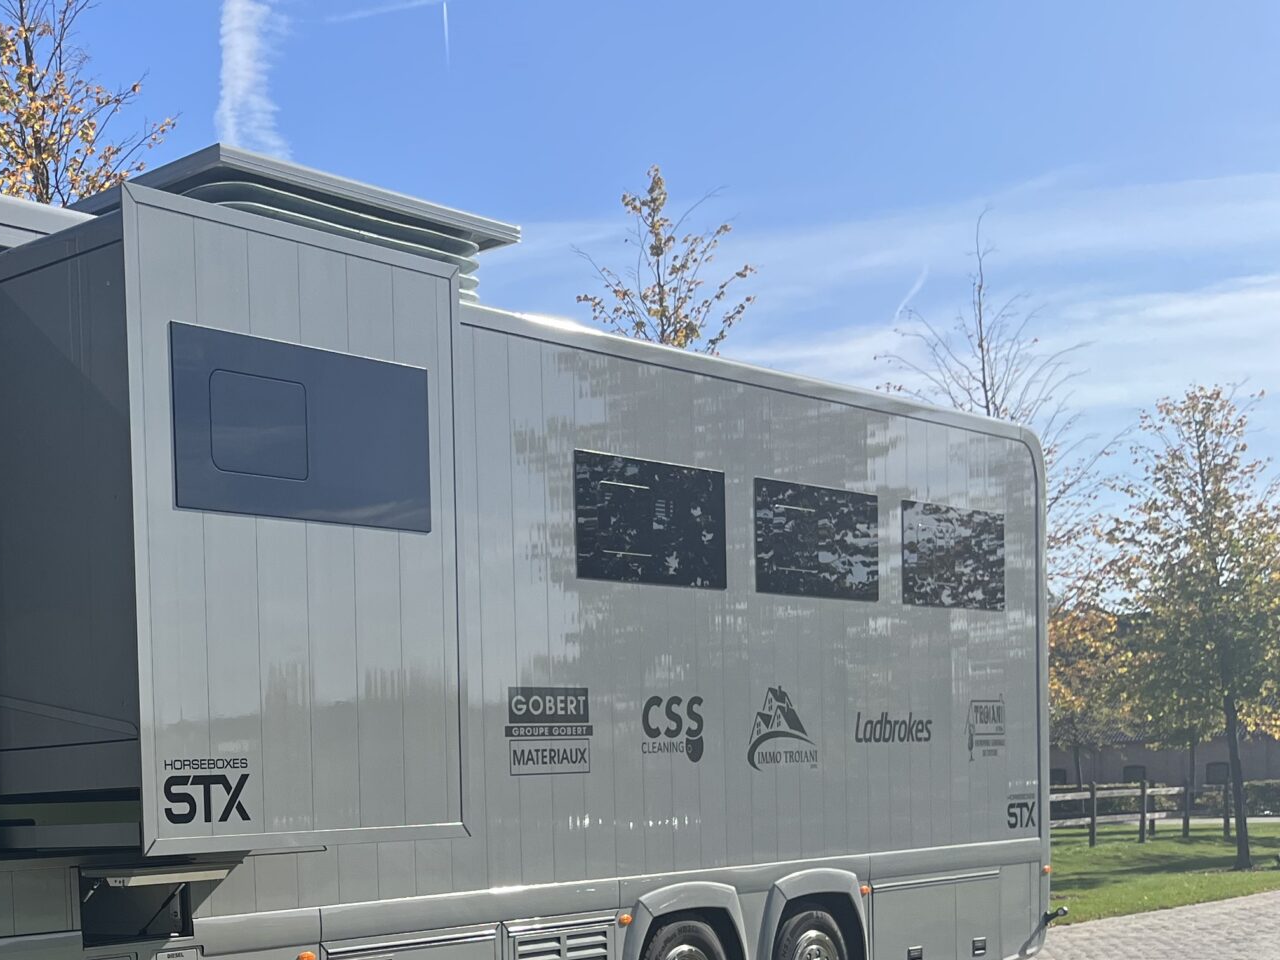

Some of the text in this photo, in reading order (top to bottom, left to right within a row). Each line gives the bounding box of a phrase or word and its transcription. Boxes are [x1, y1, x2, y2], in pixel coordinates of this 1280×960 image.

[511, 695, 586, 715] GOBERT
[642, 695, 704, 738] CSS
[512, 726, 587, 736] GROUPE GOBERT
[855, 711, 933, 743] Ladbrokes
[512, 747, 587, 766] MATERIAUX
[641, 741, 685, 754] CLEANING
[757, 750, 818, 764] IMMO TROIANI
[164, 758, 249, 770] HORSEBOXES
[163, 773, 251, 824] STX
[1007, 801, 1036, 829] STX
